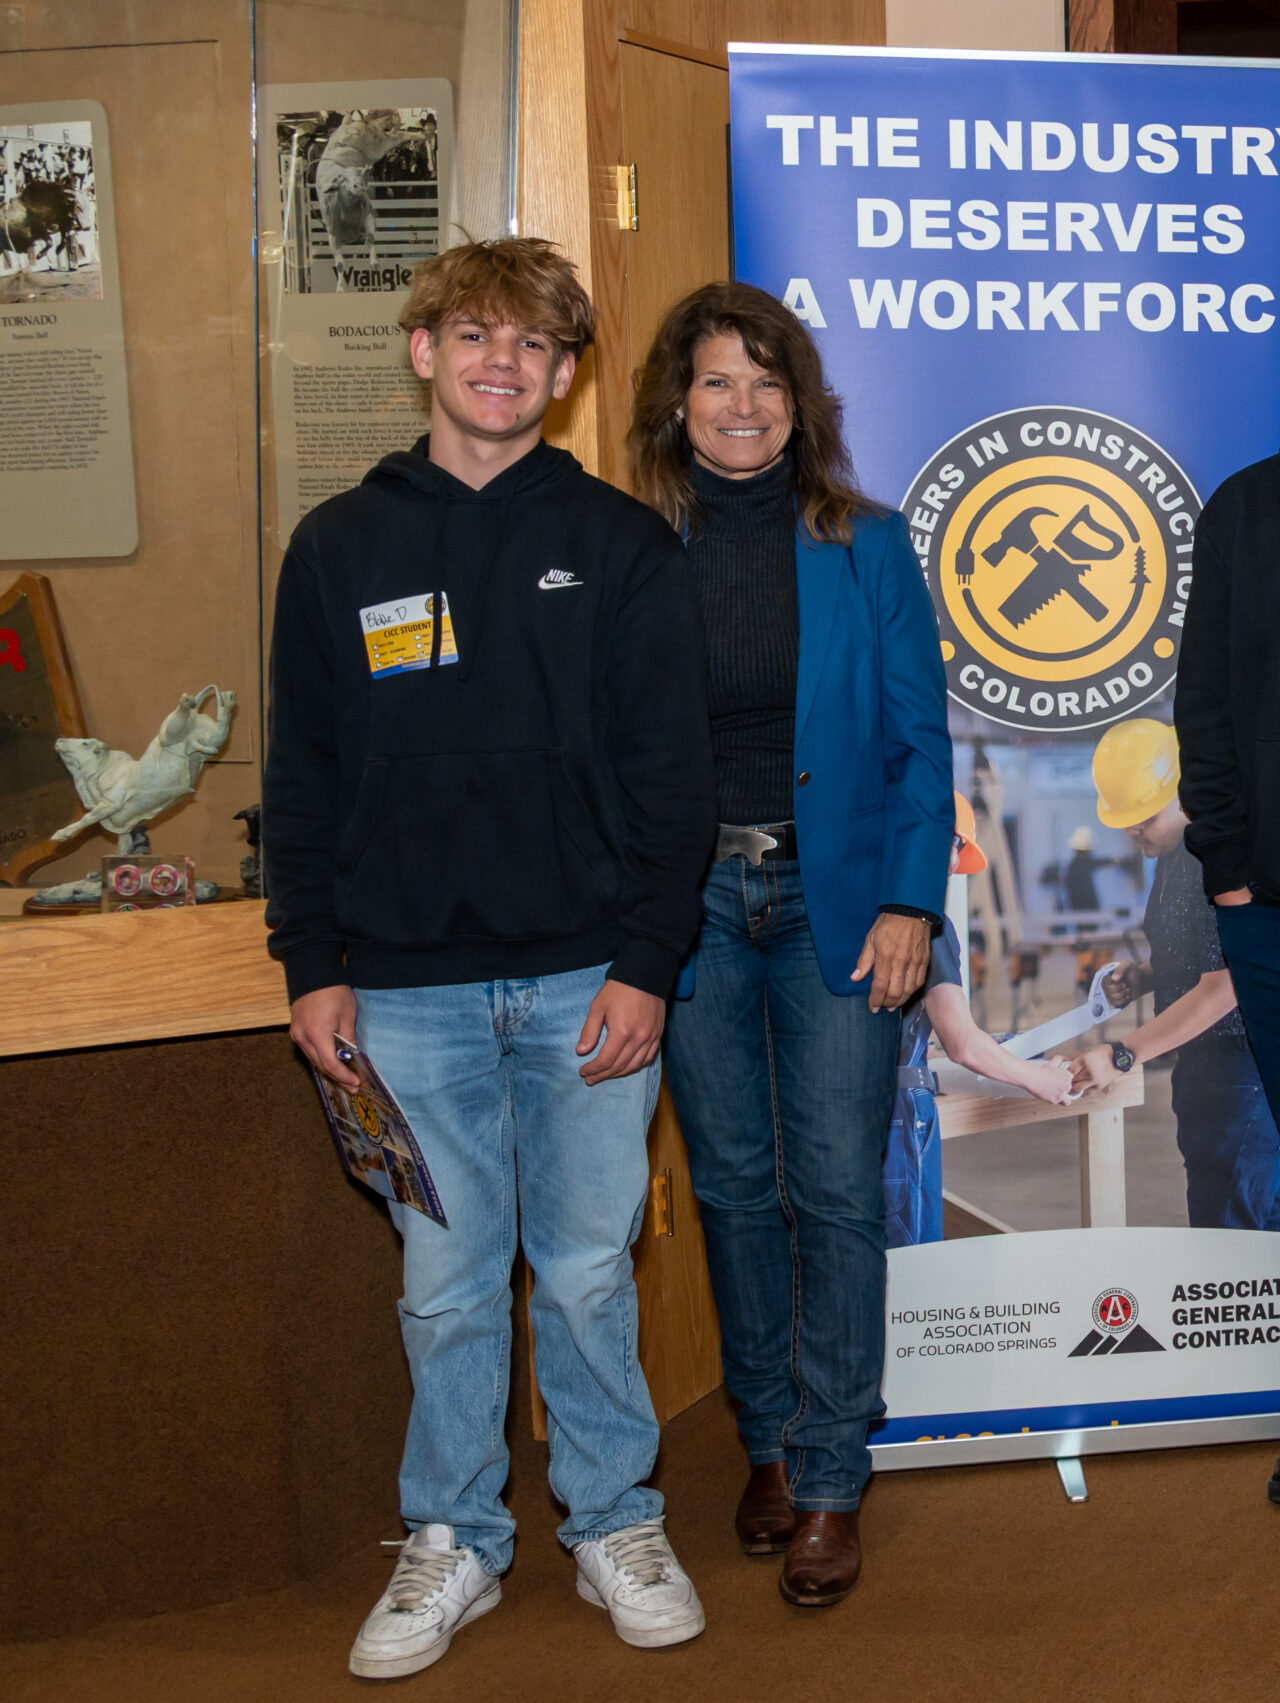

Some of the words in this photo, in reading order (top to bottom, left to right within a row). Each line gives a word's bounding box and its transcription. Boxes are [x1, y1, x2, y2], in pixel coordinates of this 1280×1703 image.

[766, 115, 920, 168] THE
[856, 198, 1245, 254] DESERVES
[332, 264, 413, 292] Wrangle
[782, 278, 828, 328] A
[0, 314, 57, 327] TORNADO
[329, 325, 401, 337] BODACIOUS
[909, 463, 966, 590] EERS
[966, 430, 1009, 468] IN
[546, 569, 575, 583] NIKE
[384, 628, 398, 638] CICC
[400, 621, 432, 635] STUDENT
[959, 662, 1153, 717] COLORADO
[892, 1307, 965, 1324] HOUSING
[969, 1306, 980, 1319] &
[985, 1301, 1061, 1318] BUILDING
[1172, 1302, 1280, 1326] GENERAL
[923, 1321, 1031, 1340] ASSOCIATION
[896, 1347, 915, 1358] OF
[919, 1341, 994, 1357] COLORADO
[997, 1338, 1057, 1351] SPRINGS
